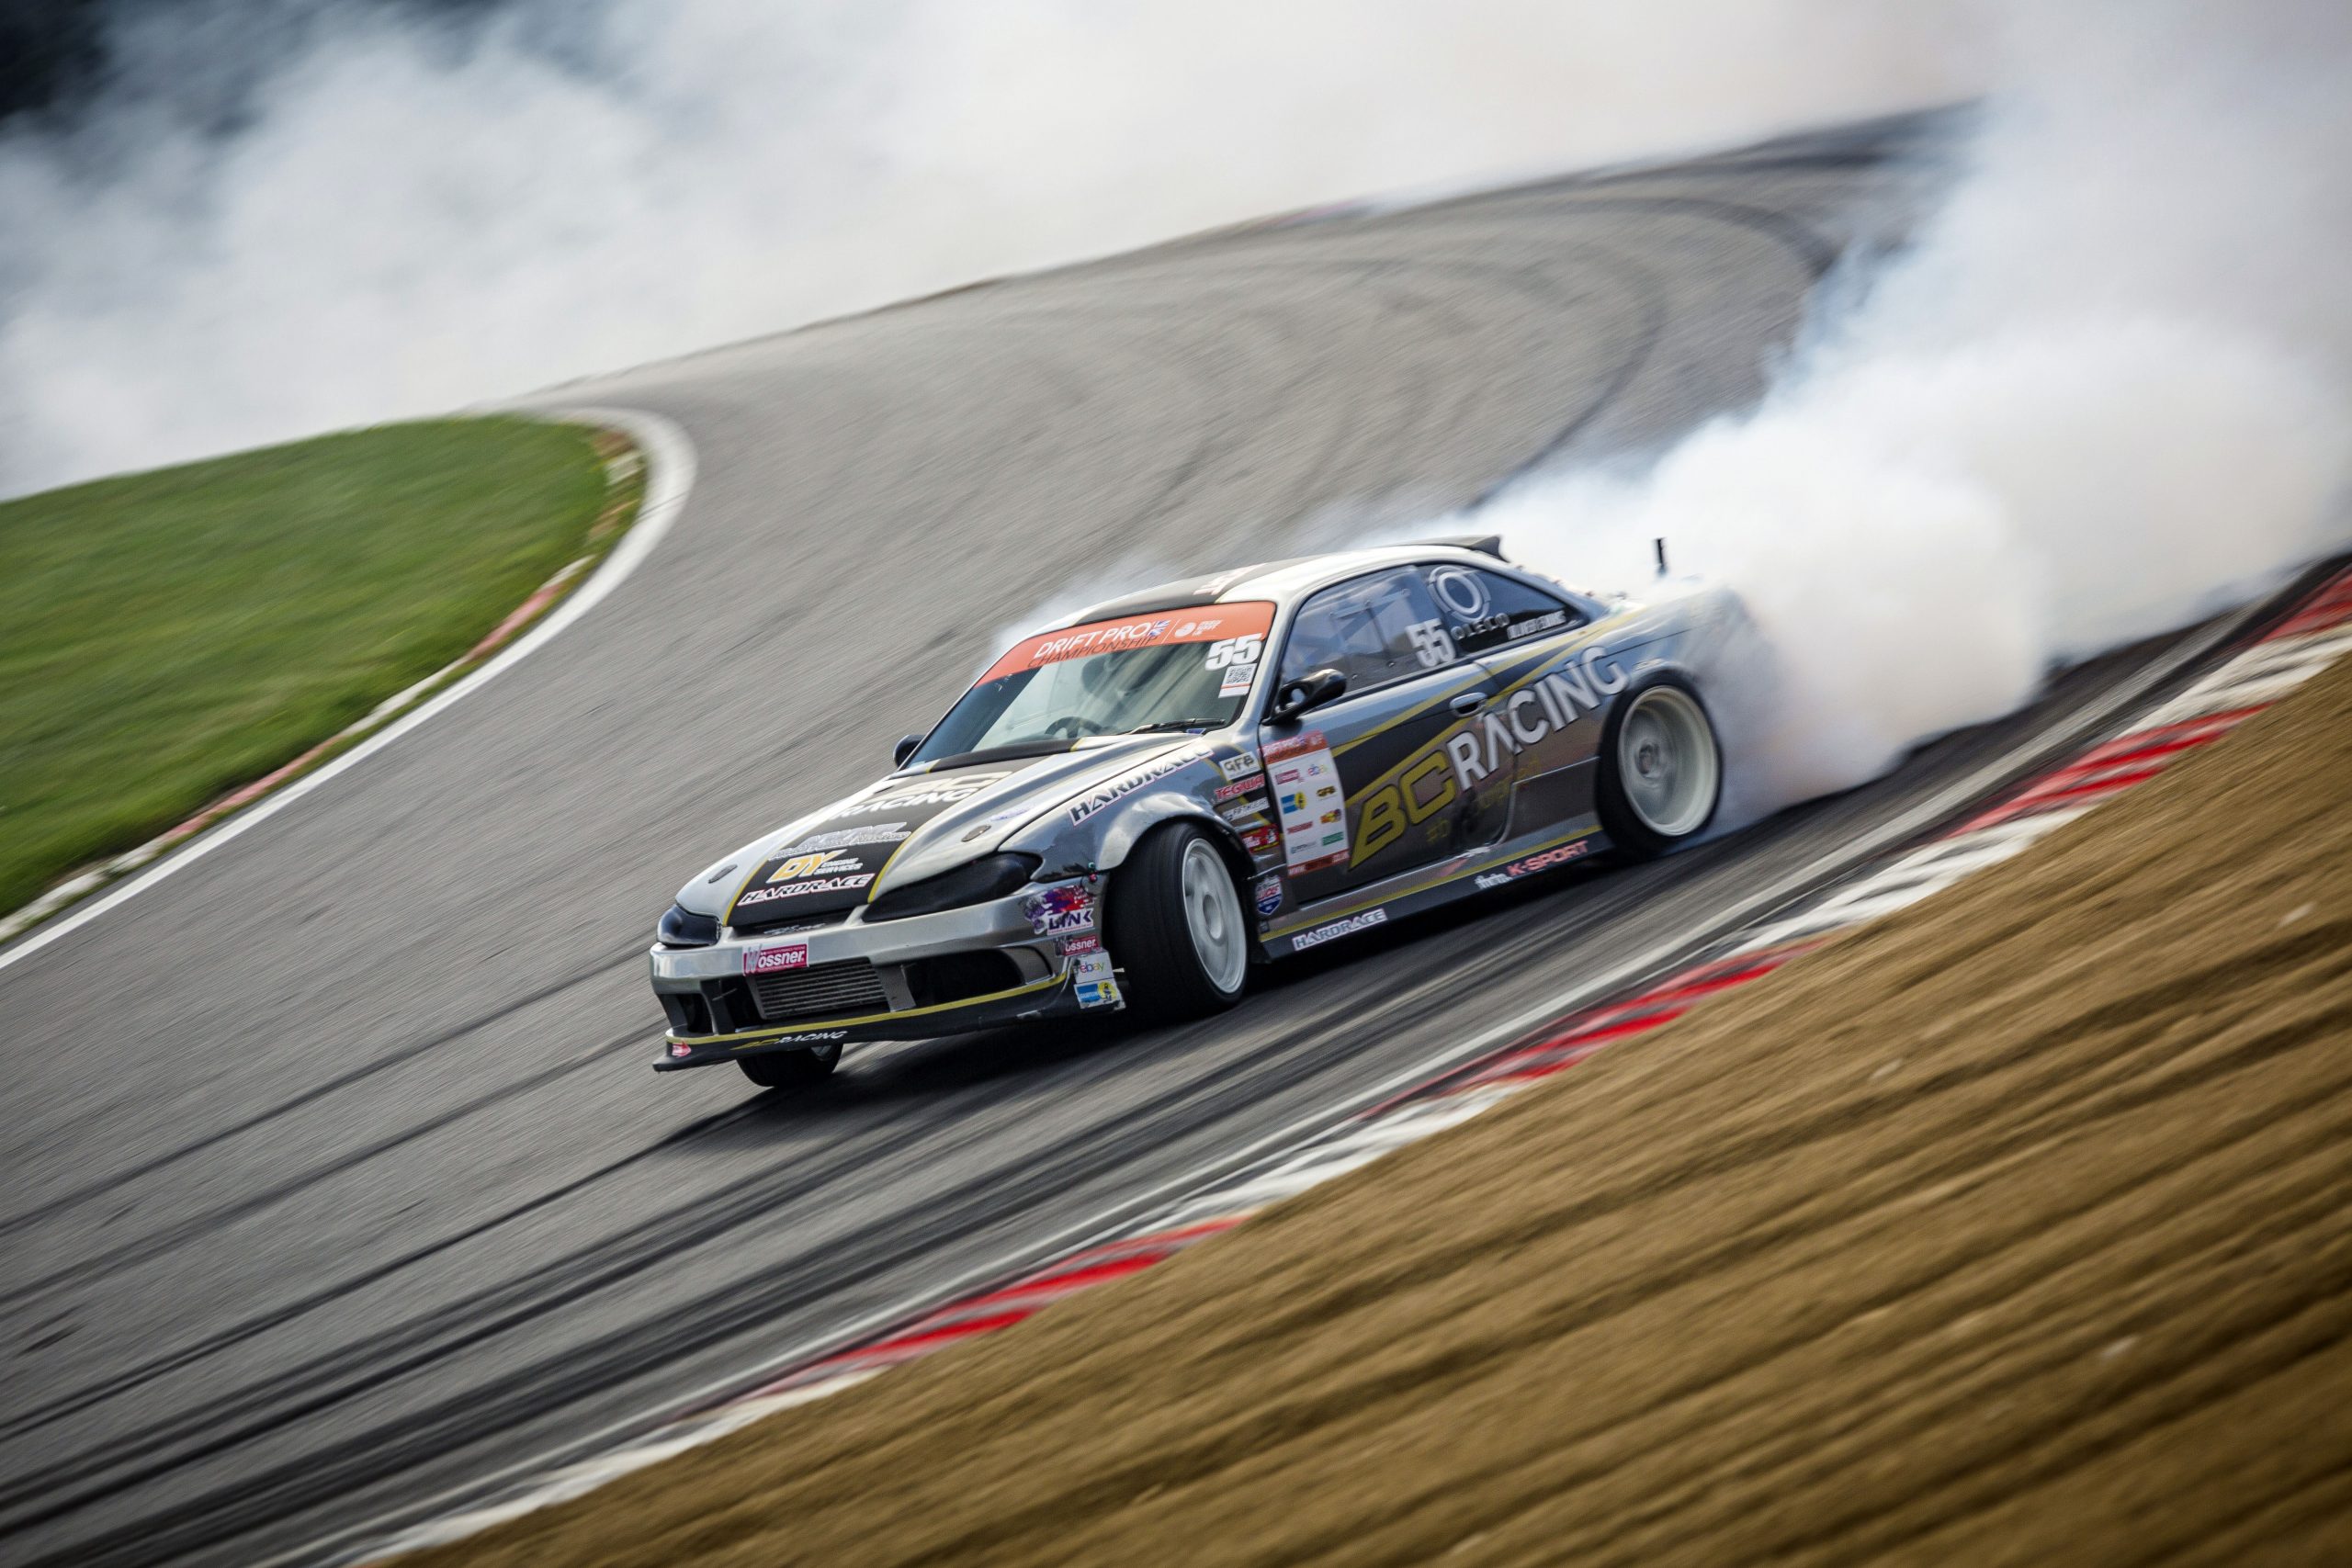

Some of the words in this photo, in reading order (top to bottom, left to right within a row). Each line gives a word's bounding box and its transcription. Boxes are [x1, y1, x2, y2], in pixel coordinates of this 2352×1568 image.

[1028, 635, 1159, 669] CHAMPIONSHIP
[1034, 632, 1098, 660] DRIFT
[1102, 621, 1153, 643] PRO
[1205, 633, 1262, 671] 55
[1404, 617, 1457, 669] 55
[1224, 754, 1256, 773] GFB
[1348, 750, 1457, 872] BC
[1445, 646, 1631, 792] RACING
[765, 848, 848, 884] DY
[1507, 840, 1589, 877] K-SPORT
[737, 873, 876, 907] HARDRACE
[1293, 908, 1388, 952] HARDRACE
[744, 944, 807, 975] Wössner
[1080, 962, 1104, 974] ebay
[775, 1030, 849, 1045] RACING
